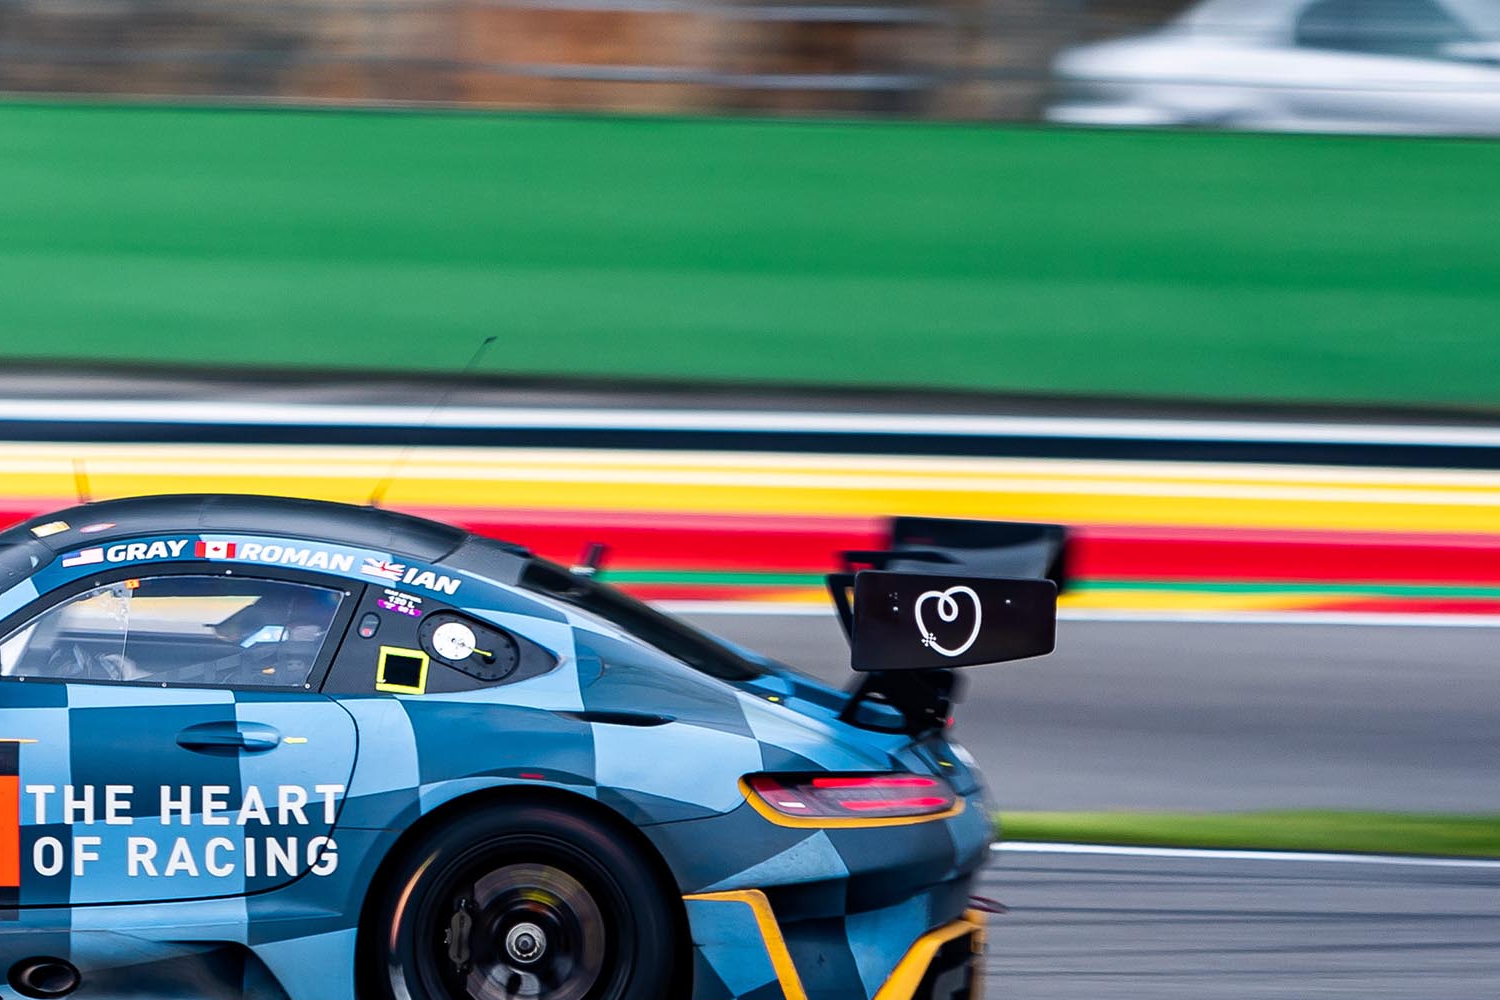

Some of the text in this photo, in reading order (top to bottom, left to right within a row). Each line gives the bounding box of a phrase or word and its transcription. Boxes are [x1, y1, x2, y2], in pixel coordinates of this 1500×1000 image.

[106, 540, 189, 562] GRAY
[238, 542, 355, 572] ROMAN
[402, 566, 462, 595] IAN
[26, 785, 345, 825] THE HEART
[33, 836, 338, 877] OF RACING
